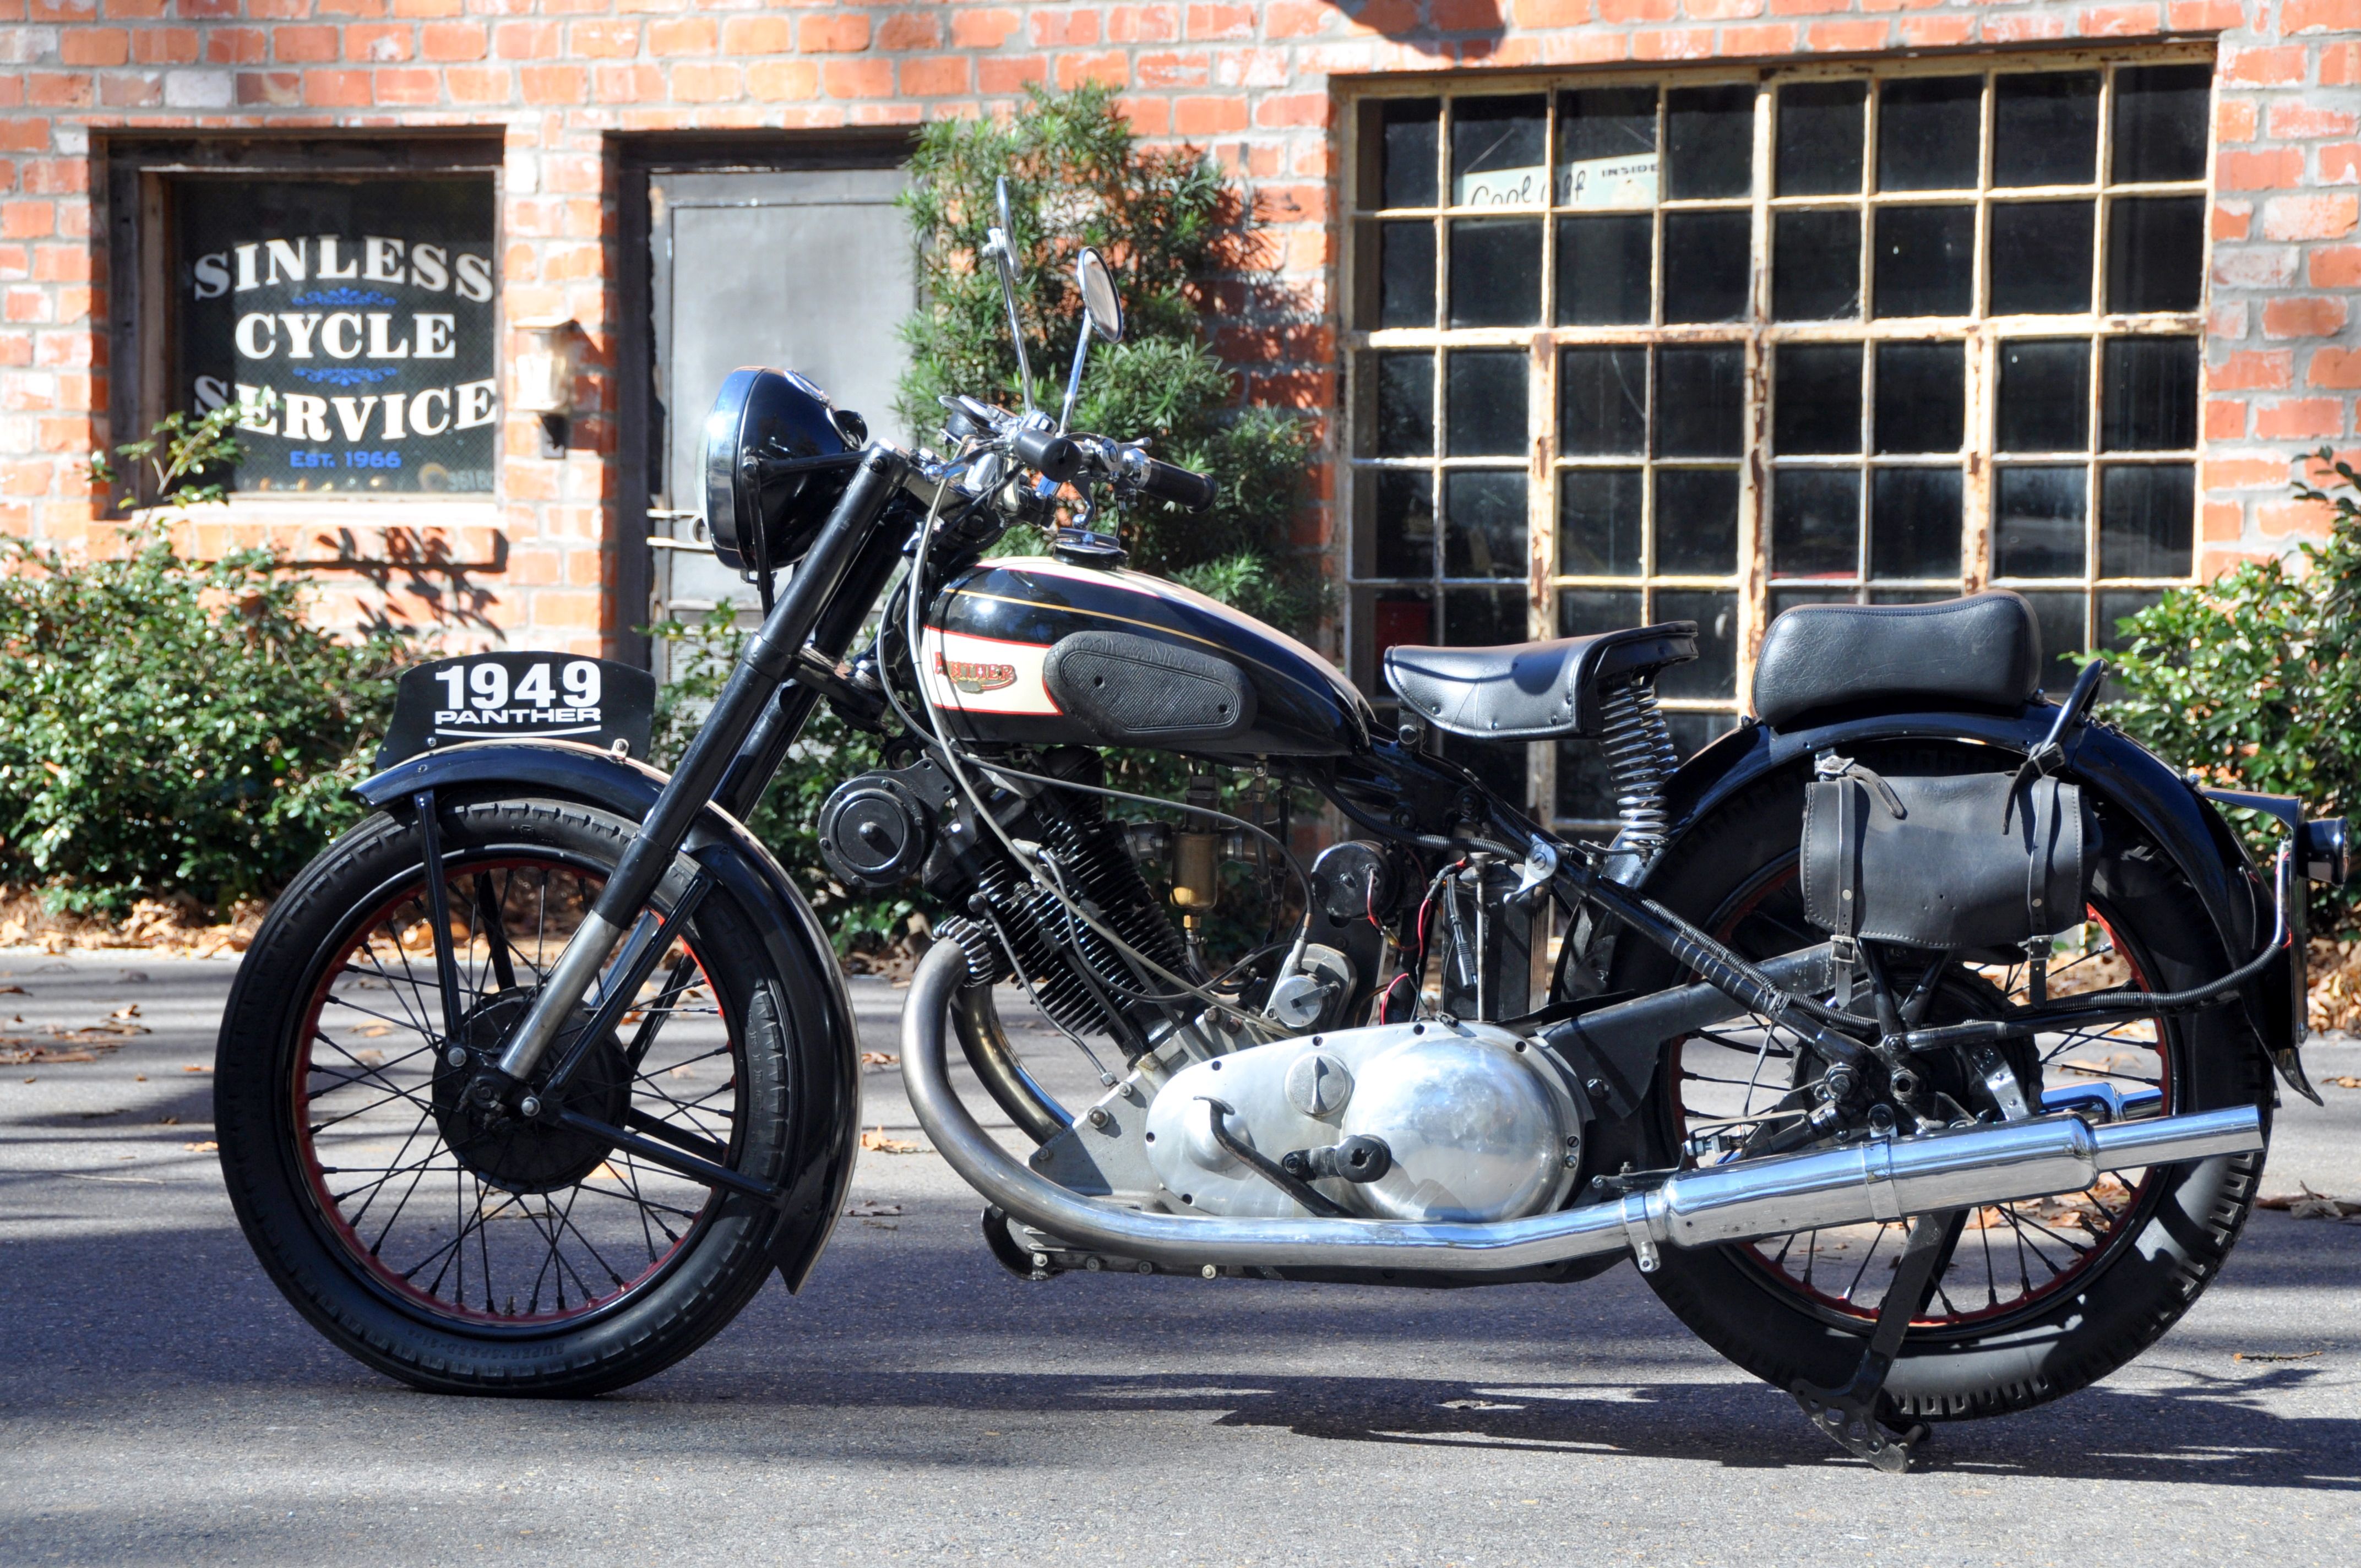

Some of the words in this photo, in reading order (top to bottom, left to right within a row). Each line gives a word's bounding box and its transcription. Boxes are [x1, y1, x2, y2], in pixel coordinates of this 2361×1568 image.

[194, 235, 493, 302] SINLESS
[235, 312, 456, 359] CYCLE
[195, 375, 496, 442] SERVICE
[344, 450, 402, 468] 1966
[435, 661, 601, 710] 1949
[434, 707, 602, 725] PANTHER
